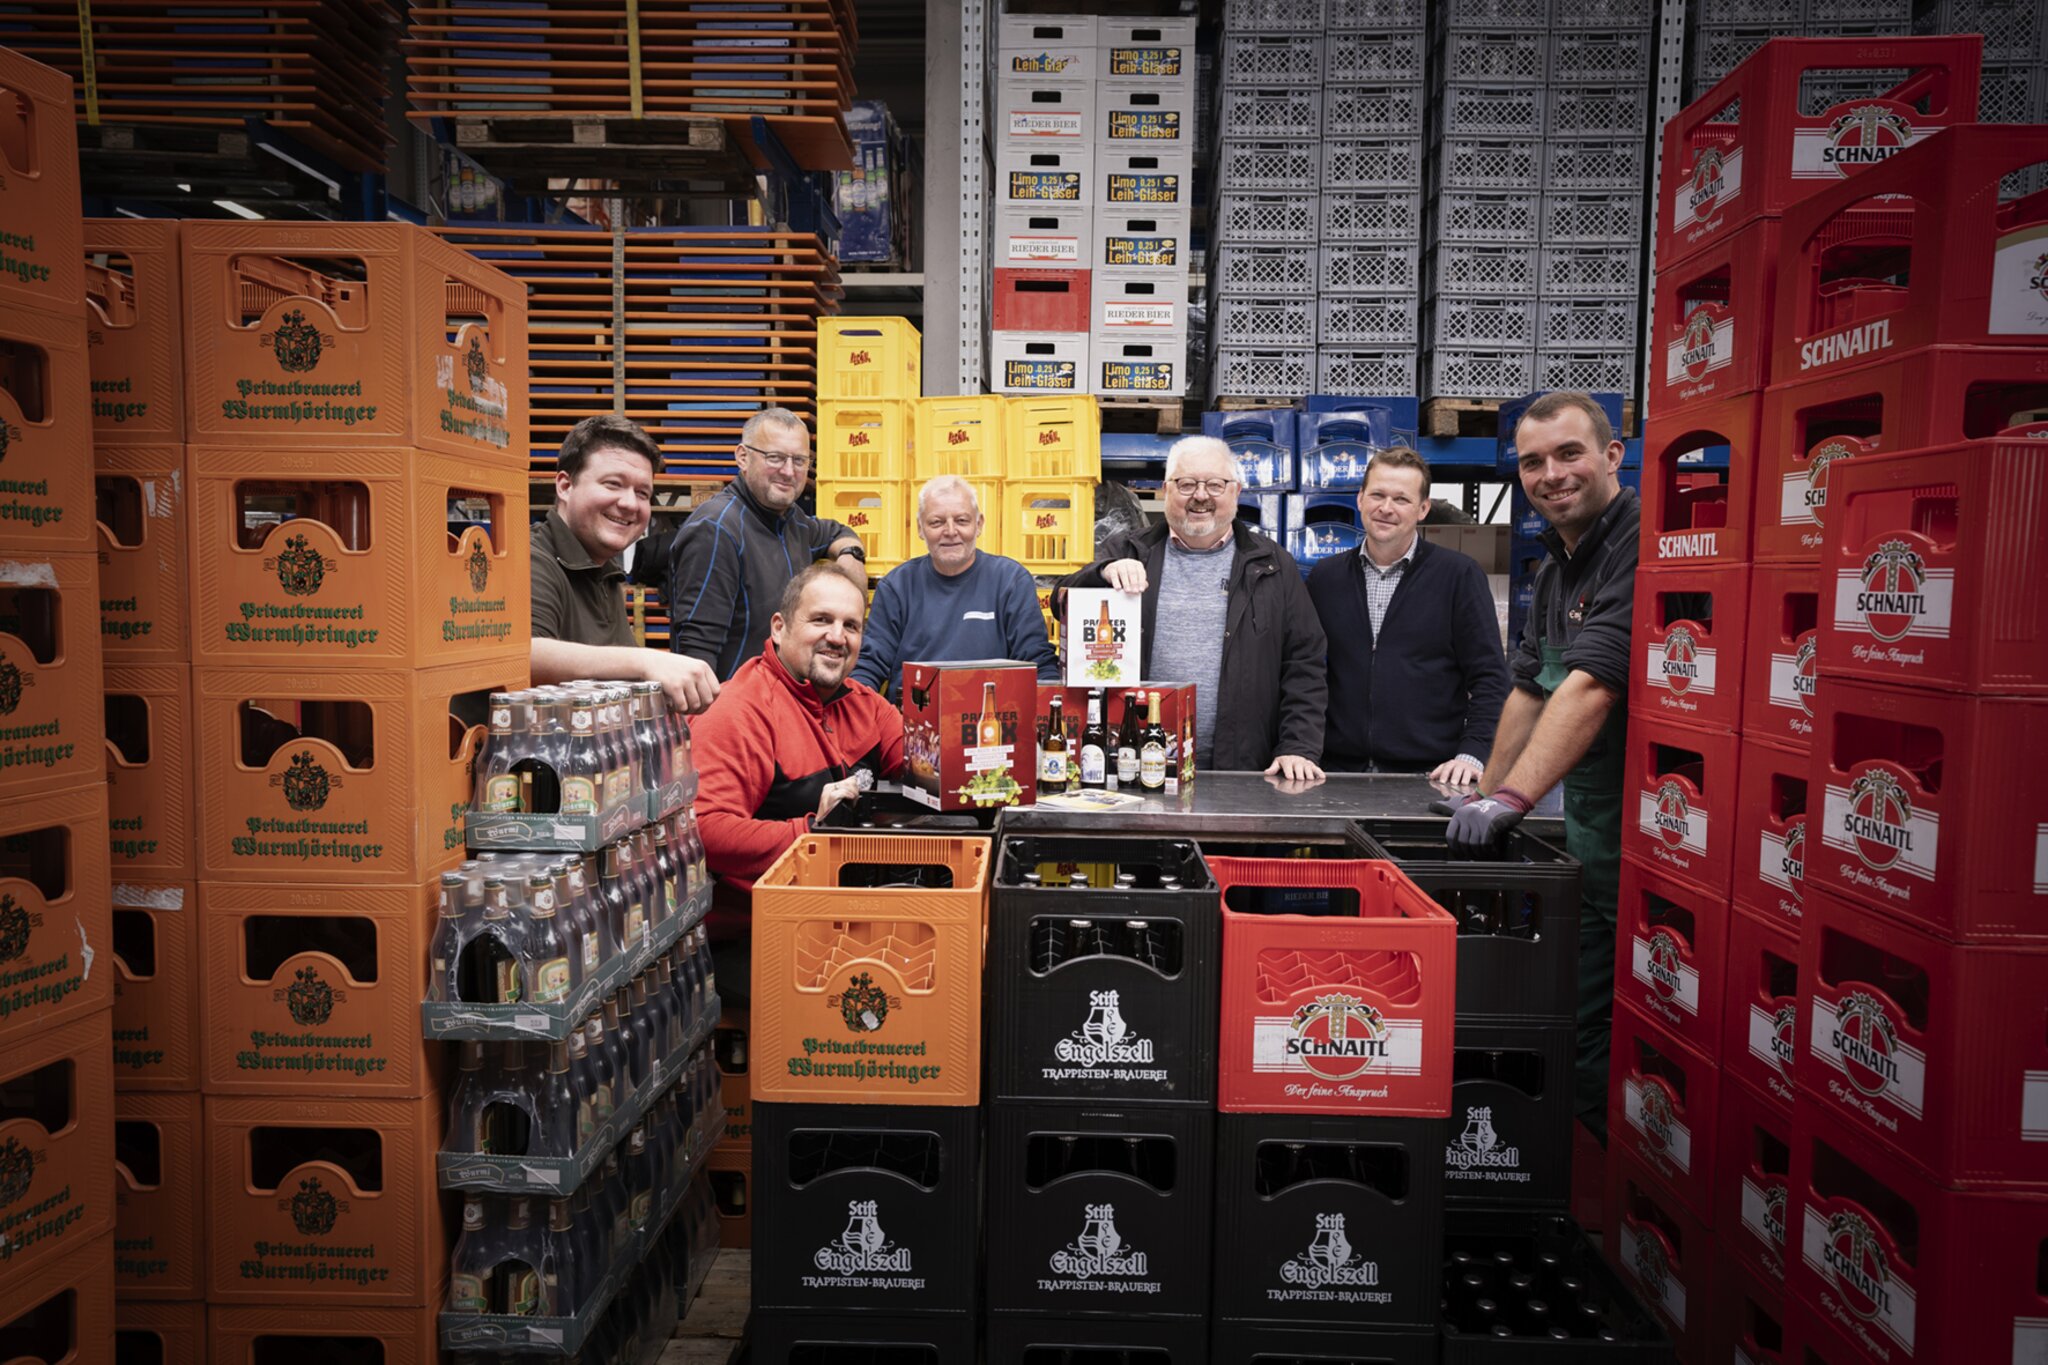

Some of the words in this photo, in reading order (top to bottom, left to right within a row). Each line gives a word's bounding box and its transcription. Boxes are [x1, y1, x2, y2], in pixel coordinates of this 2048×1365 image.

[1114, 49, 1139, 61] Limo
[1013, 119, 1052, 129] RIEDER
[1053, 120, 1078, 129] BIER
[1112, 112, 1138, 125] Limo
[1111, 124, 1179, 139] Leih-Gläser
[1012, 172, 1039, 186] Limo
[1111, 175, 1137, 188] Limo
[1012, 185, 1078, 200] Leih-Gläser
[1110, 187, 1176, 202] Leih-Gläser
[1690, 177, 1724, 210] SCHNAITL
[1011, 244, 1050, 254] RIEDER
[1050, 244, 1075, 254] BIER
[1109, 238, 1135, 251] Limo
[1107, 310, 1145, 319] RIEDER
[1146, 310, 1171, 319] BIER
[1801, 318, 1893, 371] SCHNAITL
[1681, 343, 1715, 367] SCHNAITL
[1008, 361, 1034, 374] Limo
[1105, 363, 1131, 376] Limo
[237, 379, 362, 398] Privatbrauerei
[1008, 373, 1073, 388] Leih-Gläser
[222, 400, 377, 425] Wurmhöringer
[1658, 532, 1718, 559] SCHNAITL
[239, 602, 363, 621] Privatbrauerei
[1857, 592, 1926, 615] SCHNAITL
[225, 622, 378, 648] Wurmhöringer
[1662, 662, 1698, 678] SCHNAITL
[246, 817, 368, 836] Privatbrauerei
[1655, 811, 1690, 836] SCHNAITL
[1845, 813, 1914, 852] SCHNAITL
[232, 837, 384, 863] Wurmhöringer
[1647, 960, 1682, 992] SCHNAITL
[1089, 989, 1120, 1006] Stift
[251, 1030, 372, 1049] Privatbrauerei
[802, 1038, 927, 1058] Privatbrauerei
[1287, 1037, 1388, 1057] SCHNAITL
[1054, 1038, 1154, 1068] Engelszell
[1833, 1030, 1900, 1084] SCHNAITL
[236, 1051, 387, 1076] Wurmhöringer
[787, 1058, 941, 1085] Wurmhöringer
[1041, 1068, 1167, 1081] TRAPPISTEN-BRAUEREI
[1284, 1083, 1309, 1096] Der
[1306, 1082, 1333, 1099] feine
[1334, 1084, 1389, 1101] Anspruch
[1467, 1105, 1491, 1122] Stift
[1640, 1107, 1674, 1146] SCHNAITL
[1445, 1145, 1519, 1170] ngelszell
[1445, 1170, 1531, 1182] PPISTEN-BRAUEREI
[848, 1200, 878, 1217] Stift
[1084, 1204, 1114, 1221] Stift
[1316, 1212, 1345, 1230] Stift
[254, 1241, 375, 1259] Privatbrauerei
[813, 1247, 912, 1277] Engelszell
[1049, 1252, 1148, 1281] Engelszell
[239, 1260, 389, 1285] Wurmhöringer
[1279, 1262, 1379, 1288] Engelszell
[1824, 1242, 1892, 1315] SCHNAITL
[801, 1276, 925, 1290] TRAPPISTEN-BRAUEREI
[1037, 1280, 1161, 1293] TRAPPISTEN-BRAUEREI
[1267, 1289, 1392, 1304] TRAPPISTEN-BRAUEREI
